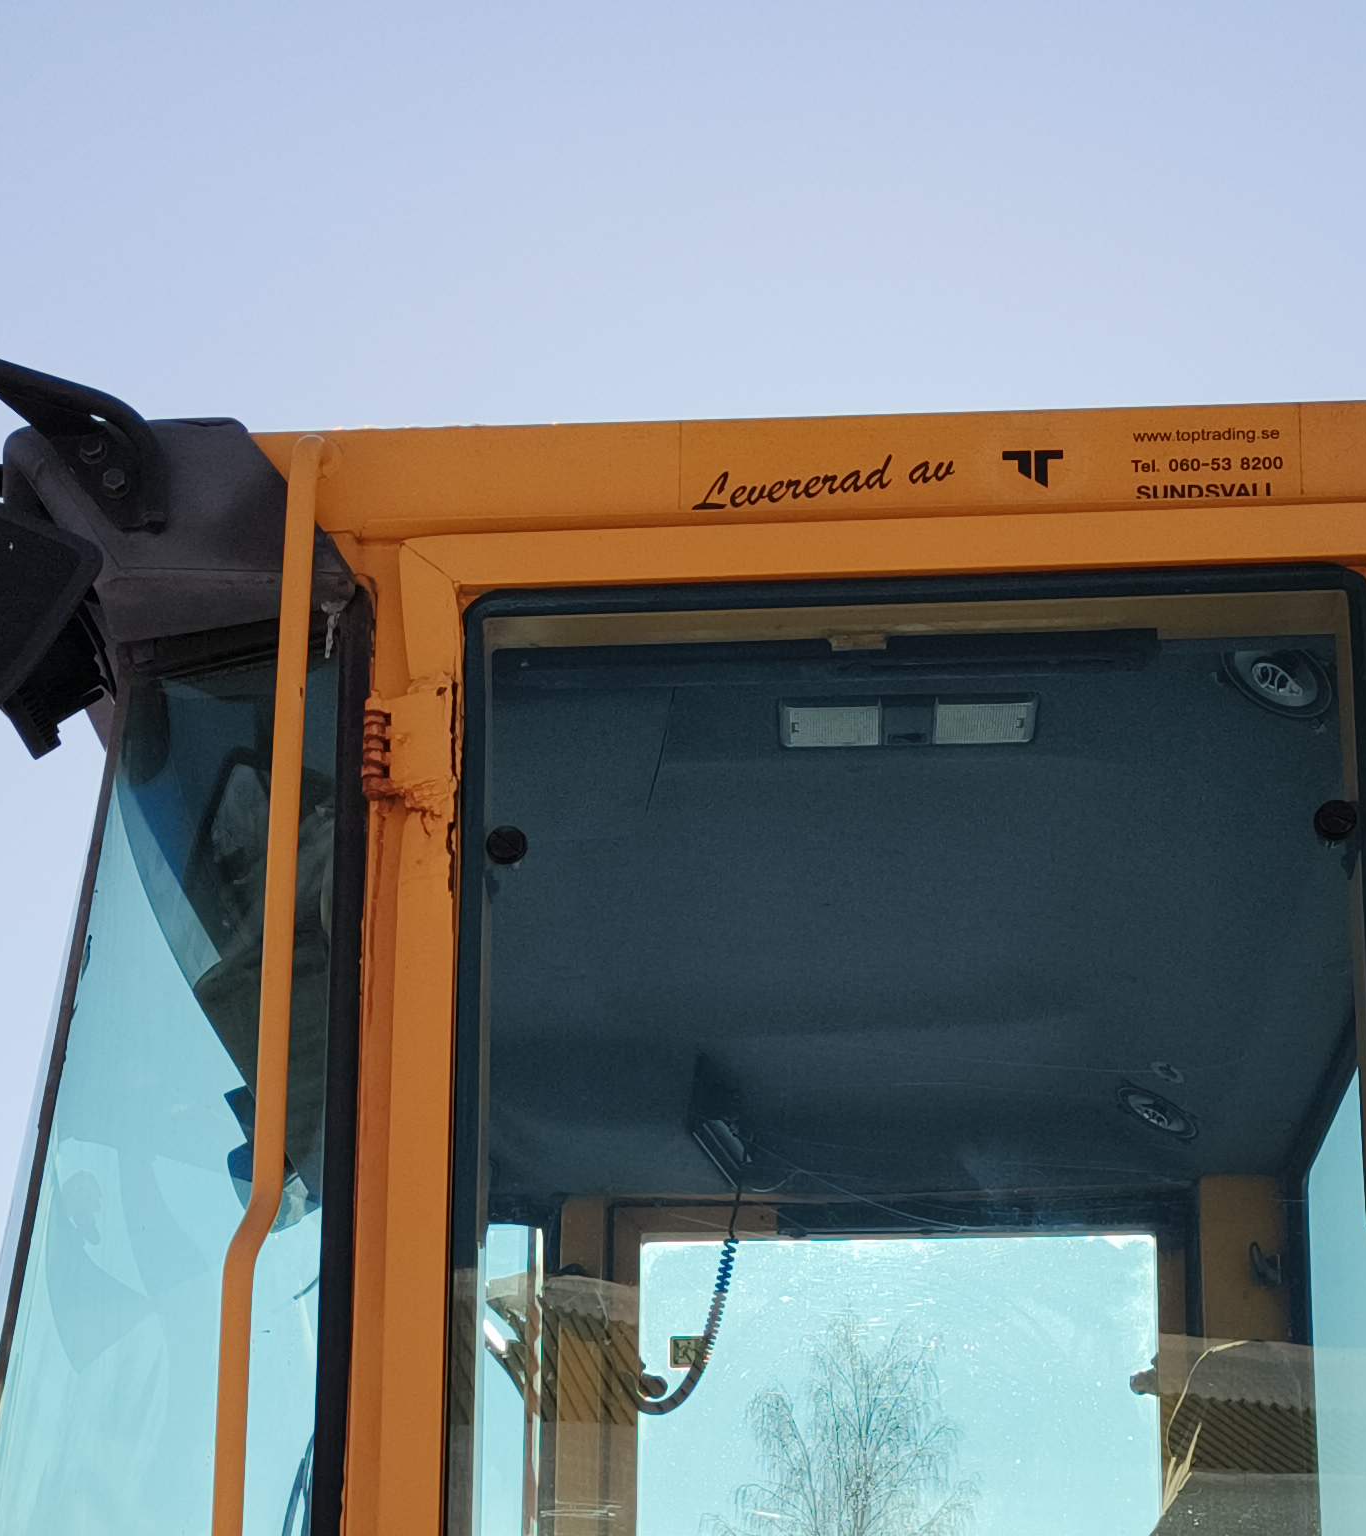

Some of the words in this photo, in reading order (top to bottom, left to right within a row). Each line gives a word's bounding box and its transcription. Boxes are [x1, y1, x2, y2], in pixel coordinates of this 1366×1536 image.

[1132, 427, 1281, 445] www.toptrading.se
[1131, 459, 1161, 473] Tel.
[1168, 457, 1232, 472] 060-53
[1240, 456, 1284, 471] 8200
[691, 454, 893, 510] Levererad
[908, 460, 956, 484] av
